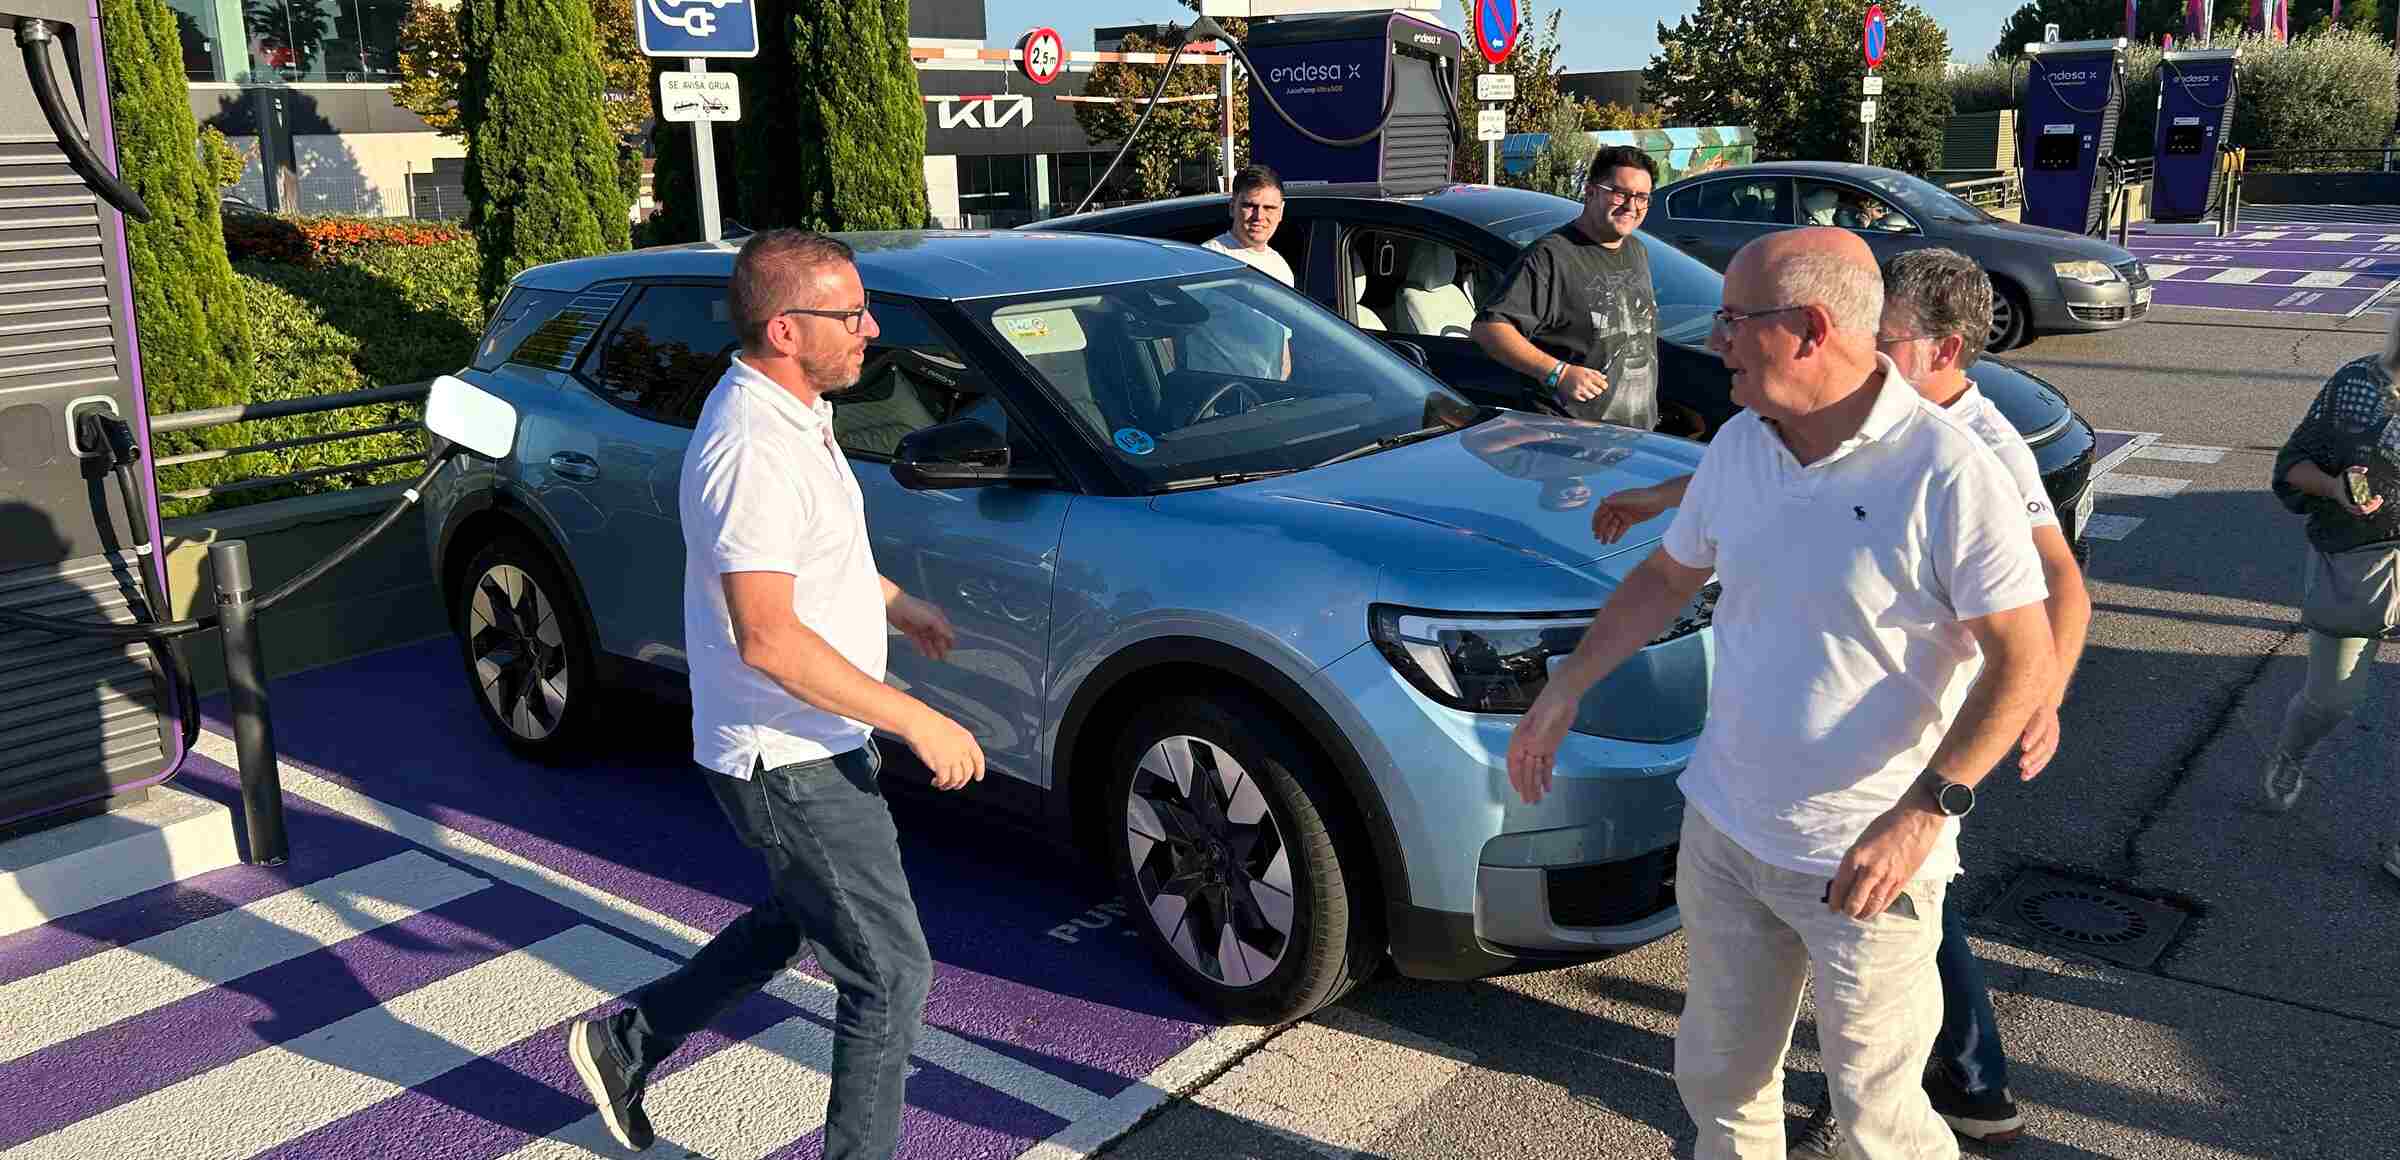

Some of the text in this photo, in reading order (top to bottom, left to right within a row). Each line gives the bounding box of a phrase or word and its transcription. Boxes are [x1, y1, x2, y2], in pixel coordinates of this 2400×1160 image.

[1270, 61, 1341, 83] endesa
[668, 80, 679, 90] SE
[682, 80, 705, 90] AVISA
